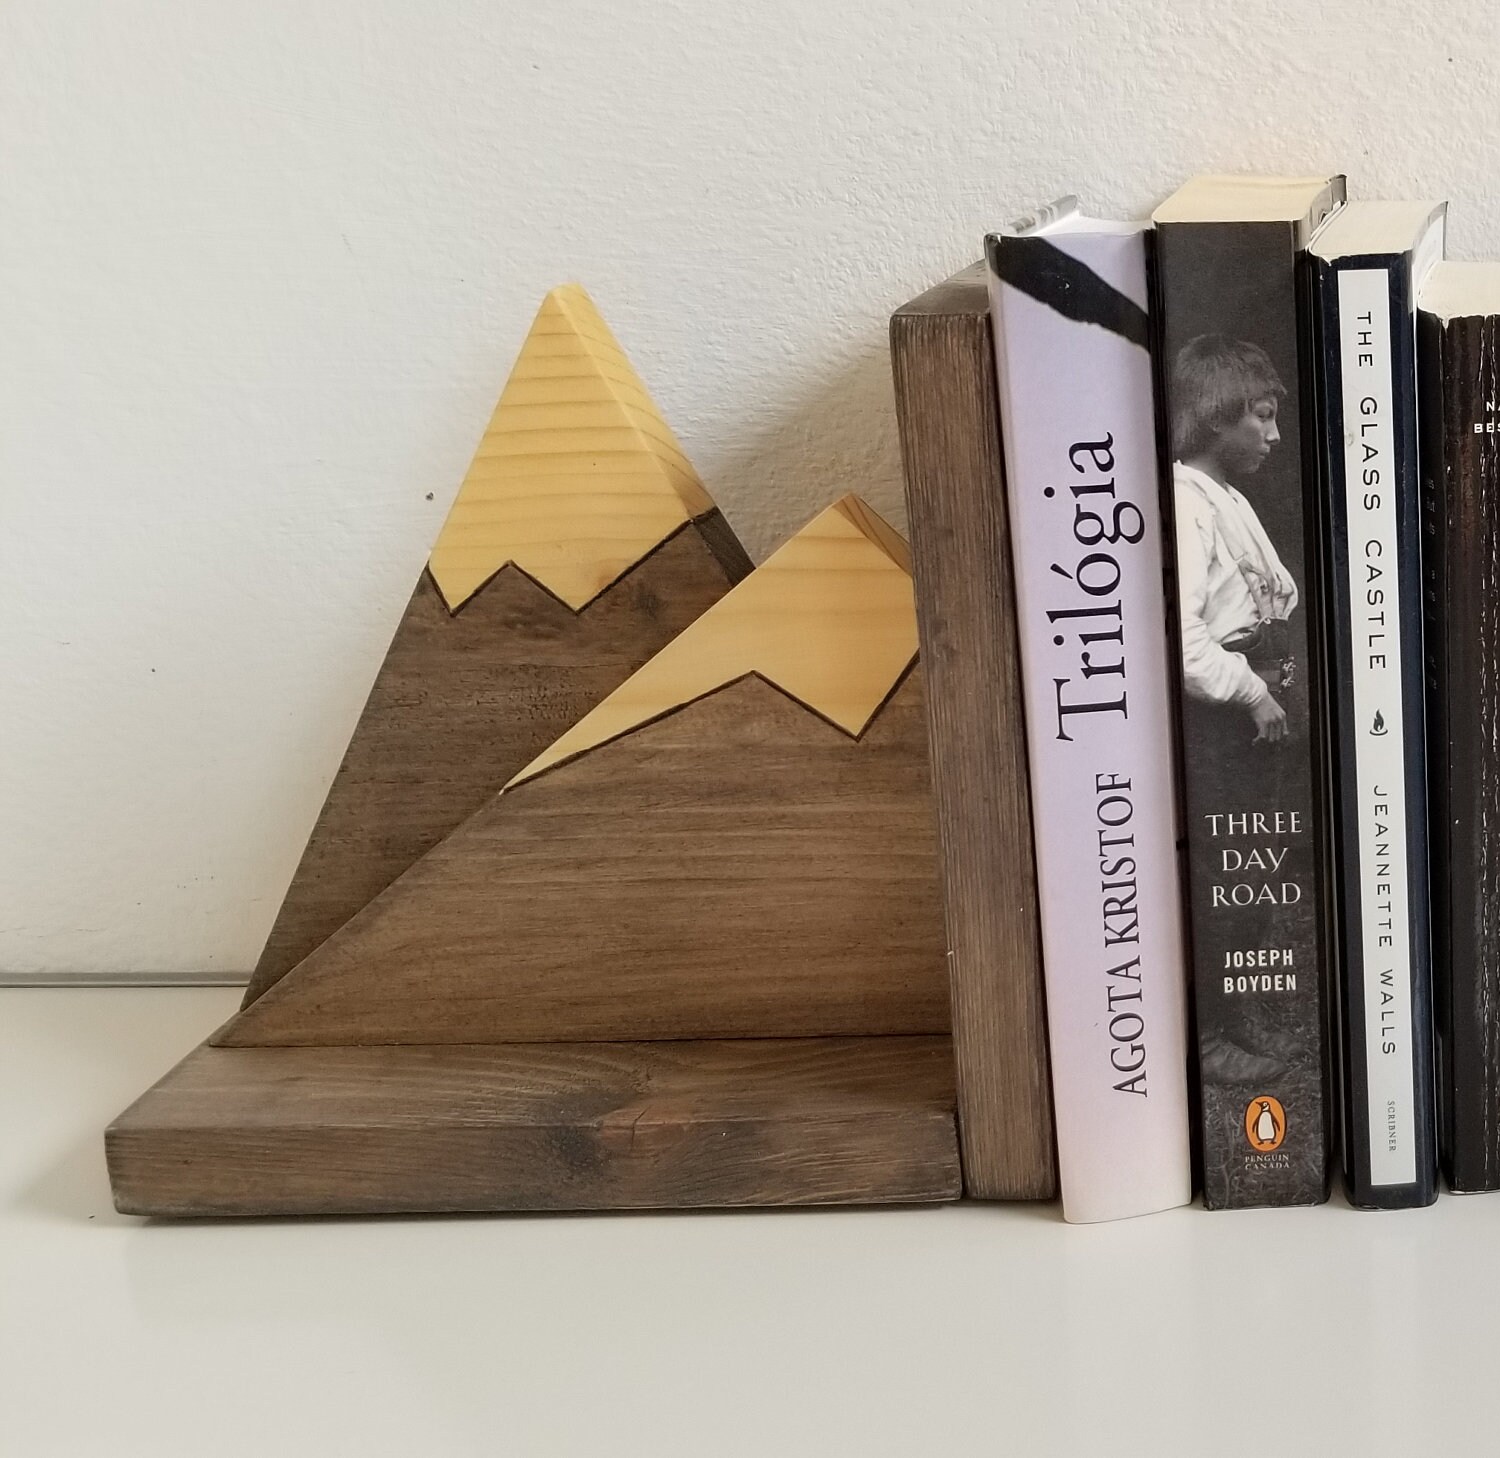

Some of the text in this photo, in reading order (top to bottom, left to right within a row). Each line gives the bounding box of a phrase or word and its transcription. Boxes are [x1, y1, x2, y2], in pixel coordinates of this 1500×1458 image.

[1356, 311, 1386, 670] THE GLASS CASTLE
[1045, 431, 1145, 741] Trilógia
[1205, 811, 1303, 836] THREE
[1221, 847, 1290, 874] DAY
[1212, 882, 1302, 907] ROAD
[1373, 785, 1396, 1055] JEANNETTE WALLS
[1096, 772, 1148, 1098] AGOTA KRISTOF
[1224, 949, 1294, 969] JOSEPH
[1224, 973, 1297, 994] BOYDEN
[1387, 1100, 1397, 1152] SCRIBNER
[1245, 1154, 1289, 1163] PENGUIN
[1245, 1162, 1290, 1170] CANADA
